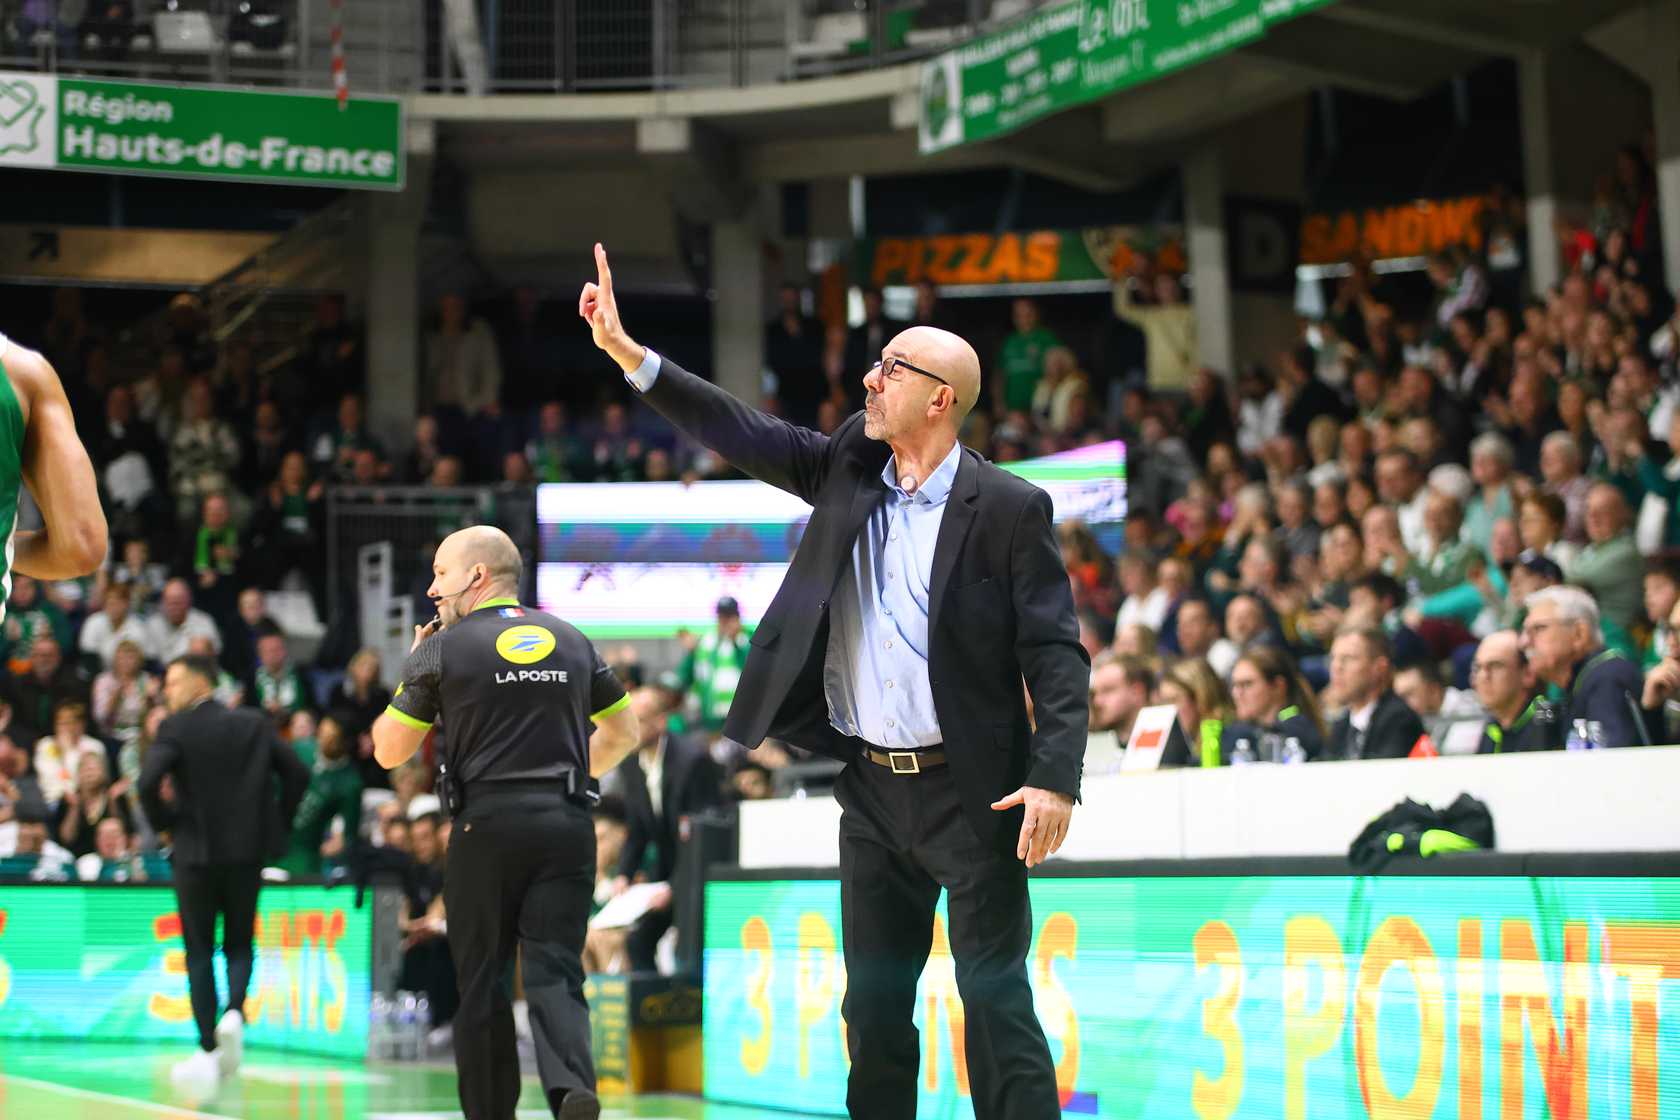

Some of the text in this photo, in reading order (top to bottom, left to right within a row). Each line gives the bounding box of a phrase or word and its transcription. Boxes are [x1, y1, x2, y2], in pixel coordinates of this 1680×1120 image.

[63, 89, 174, 124] Région
[63, 124, 395, 176] Hauts-de-France
[872, 229, 1062, 285] PIZZAS
[495, 670, 568, 684] LA POSTE
[739, 915, 773, 1076] 3
[1191, 919, 1244, 1120] 3
